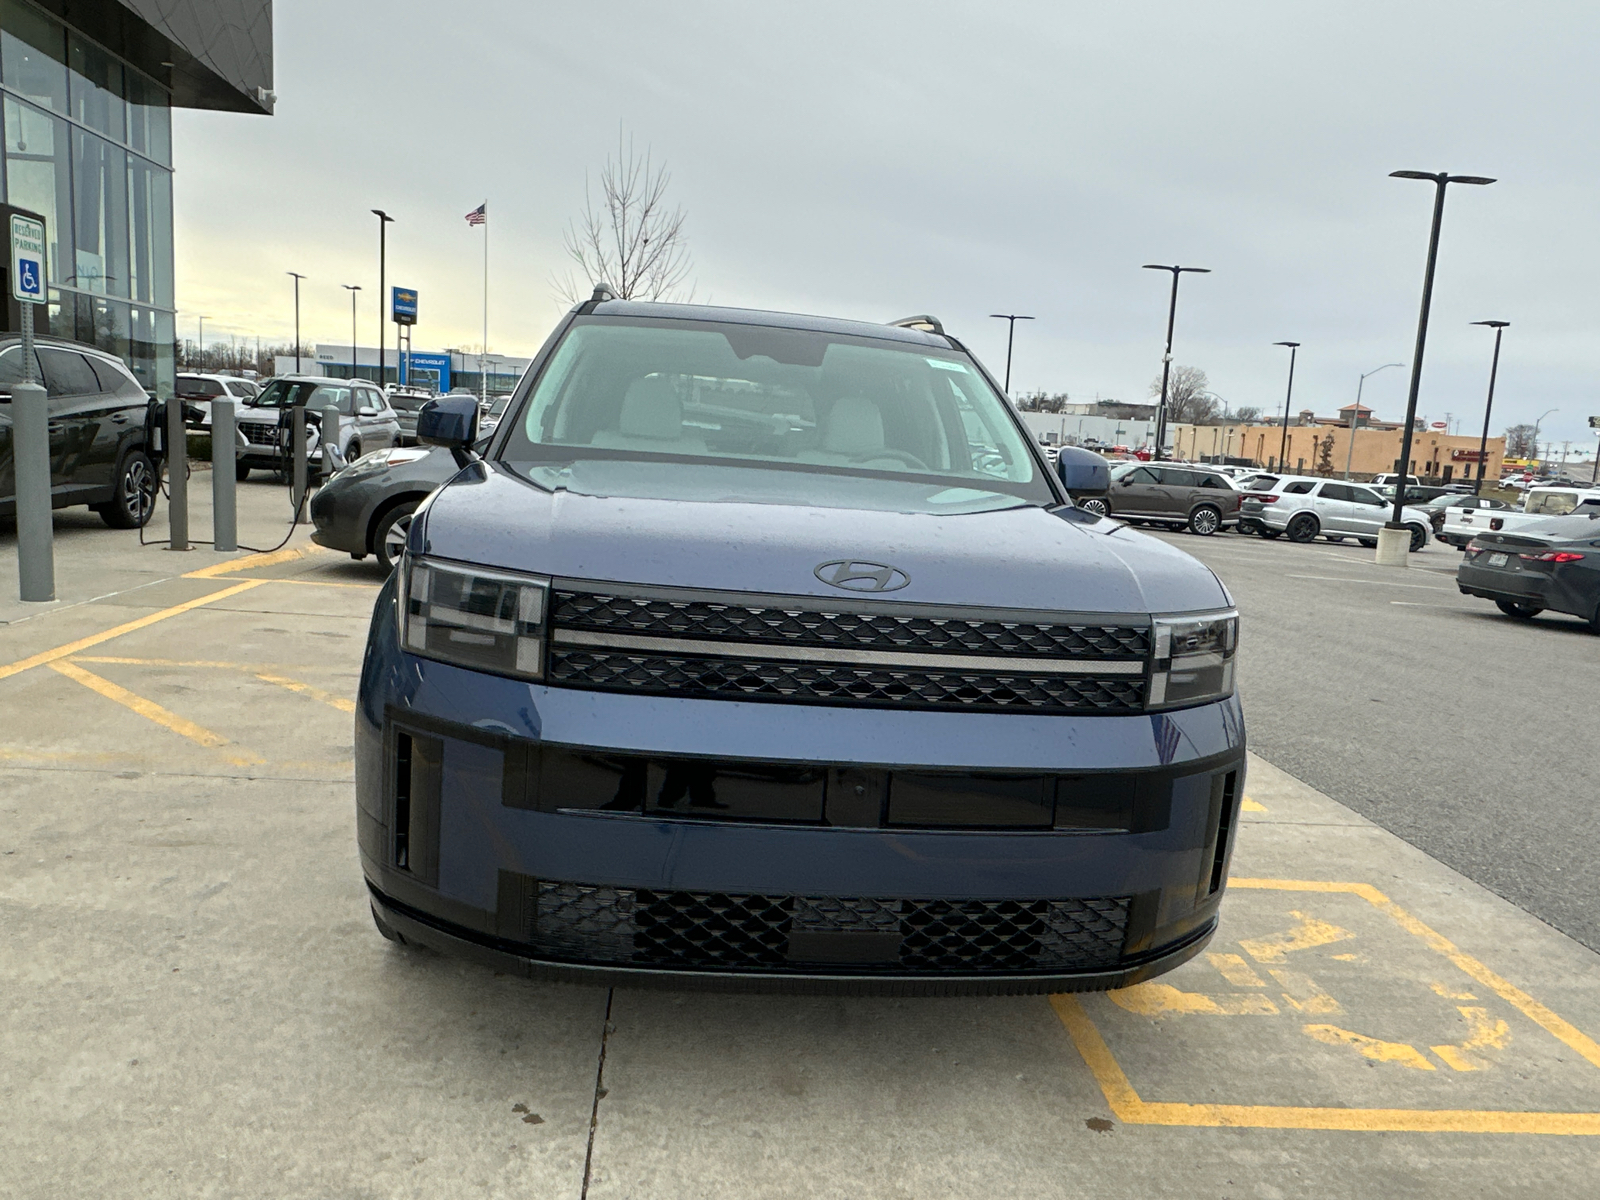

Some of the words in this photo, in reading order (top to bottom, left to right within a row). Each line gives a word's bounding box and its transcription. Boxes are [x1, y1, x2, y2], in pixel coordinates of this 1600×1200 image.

[15, 223, 41, 239] RESERVED
[15, 238, 42, 254] PARKING
[415, 358, 445, 366] CHEVROLET
[1460, 515, 1473, 524] Jeep
